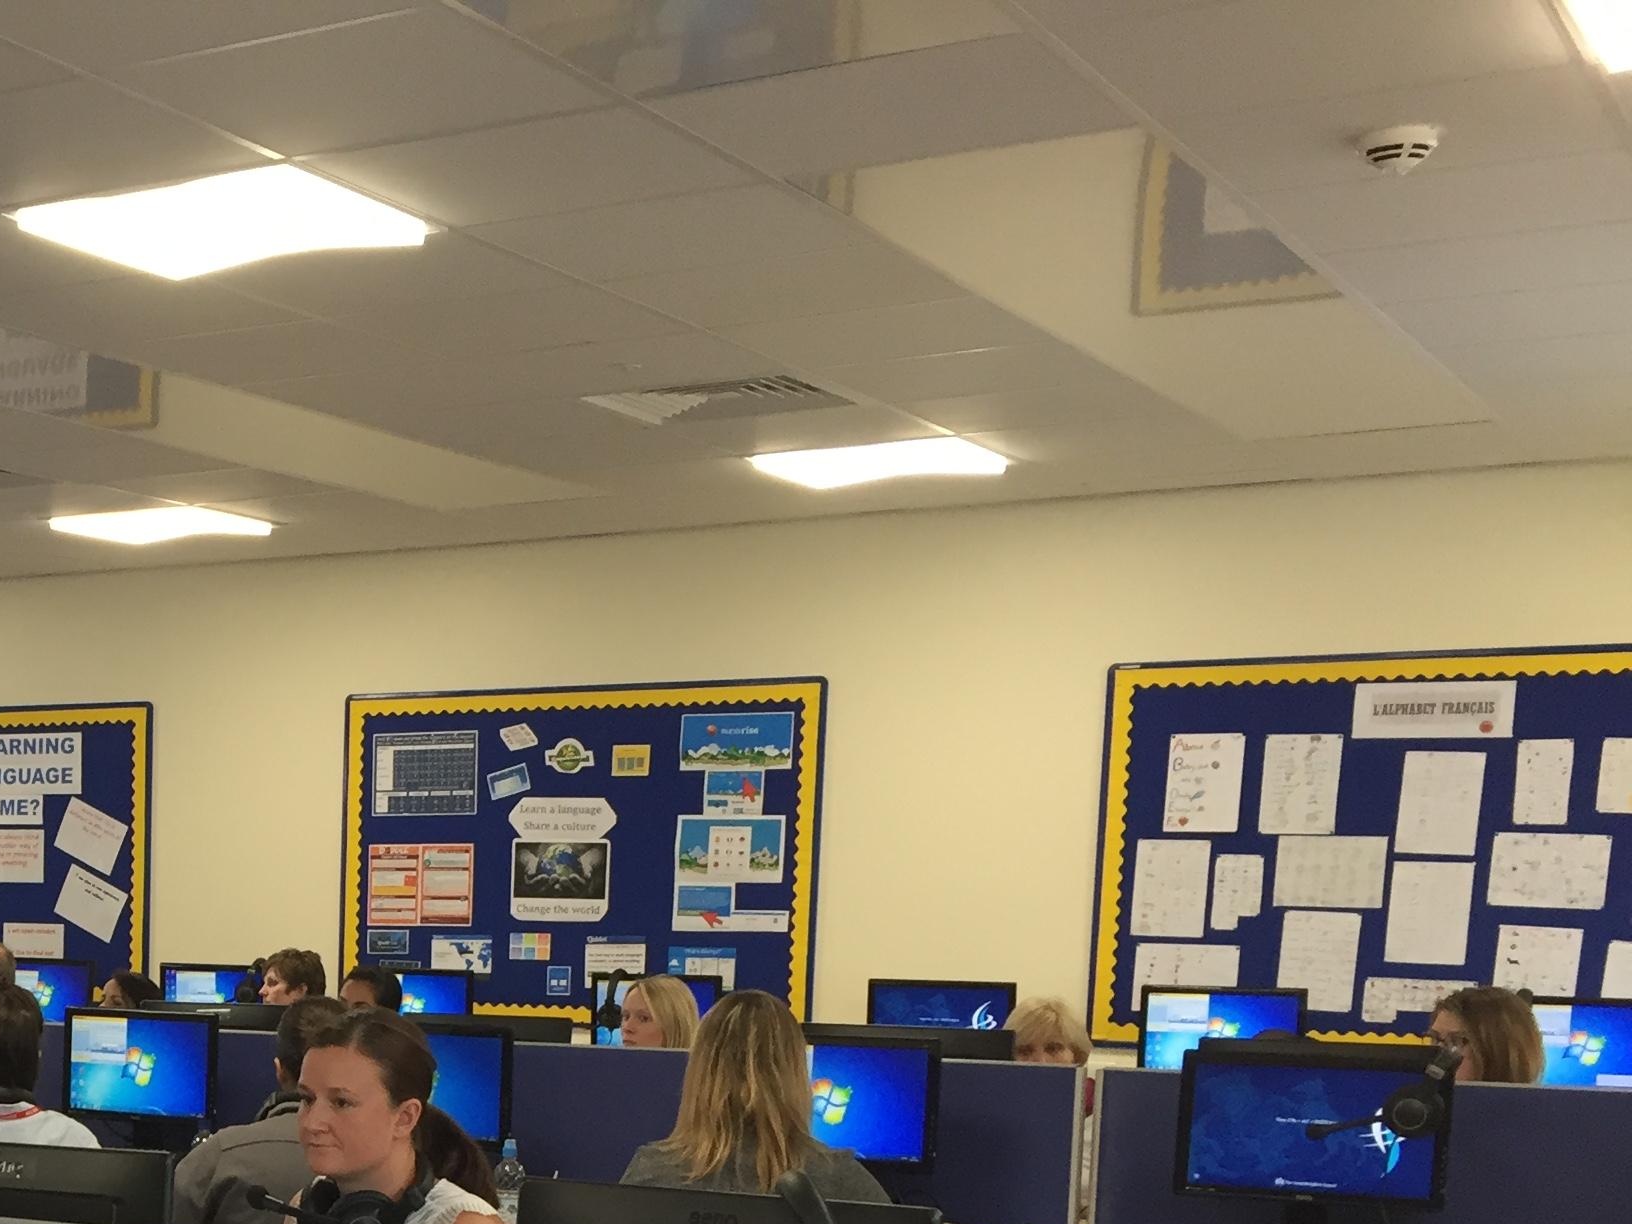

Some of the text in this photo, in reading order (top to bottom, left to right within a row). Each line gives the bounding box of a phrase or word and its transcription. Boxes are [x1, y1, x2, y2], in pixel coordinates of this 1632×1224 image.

[1372, 701, 1496, 716] L'ALPHABET FRANÇAIS
[0, 798, 41, 816] ME?
[520, 805, 547, 814] Learn
[558, 804, 602, 816] language
[523, 822, 550, 831] Share
[561, 822, 597, 831] culture
[517, 904, 601, 915] Change the world
